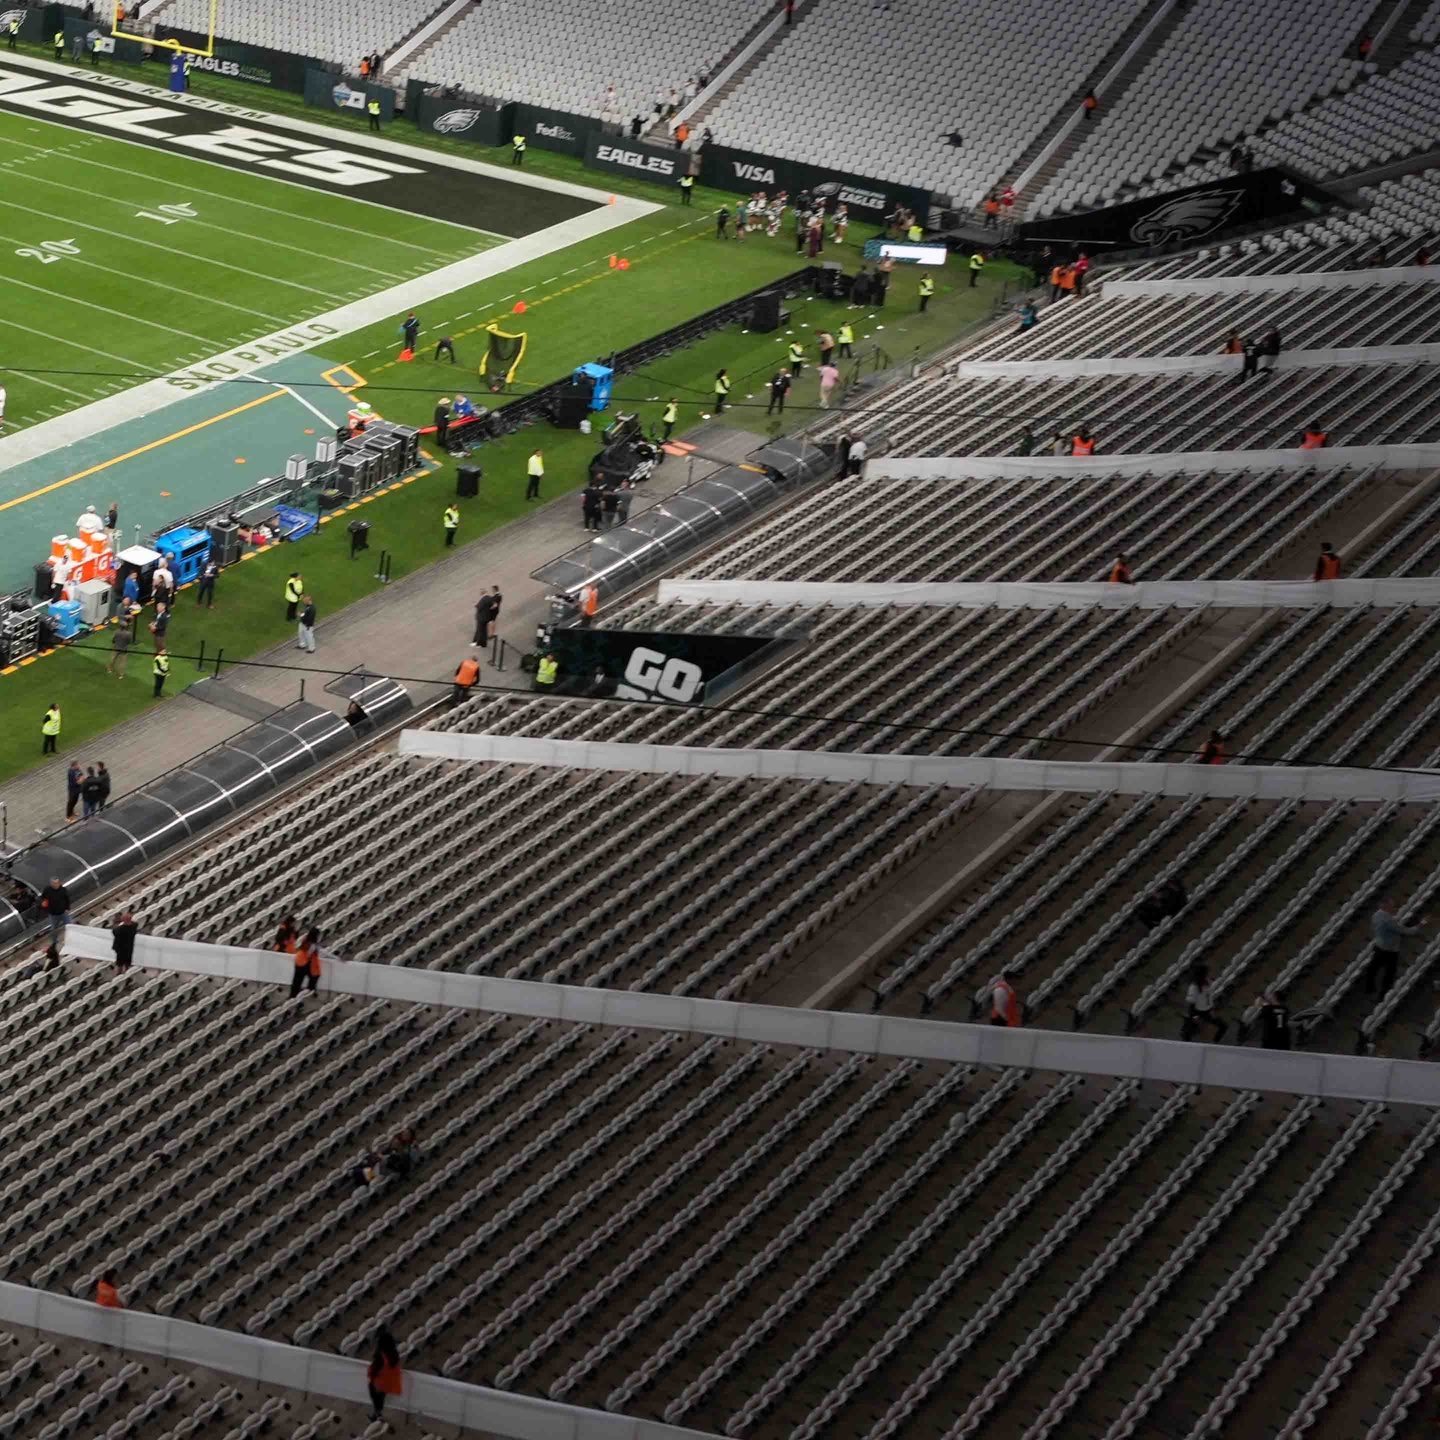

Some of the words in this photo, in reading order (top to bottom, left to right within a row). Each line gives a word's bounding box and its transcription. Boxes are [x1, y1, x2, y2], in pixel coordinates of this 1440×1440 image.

[184, 52, 241, 76] EAGLES
[71, 70, 130, 88] END
[142, 87, 270, 120] RACISM
[596, 145, 676, 175] EAGLES
[732, 162, 776, 184] VISA
[837, 191, 888, 210] EAGLES
[134, 203, 198, 225] 10
[15, 239, 81, 264] 20
[166, 362, 240, 391] SÃO
[234, 323, 340, 364] PAULO
[624, 646, 702, 703] GO
